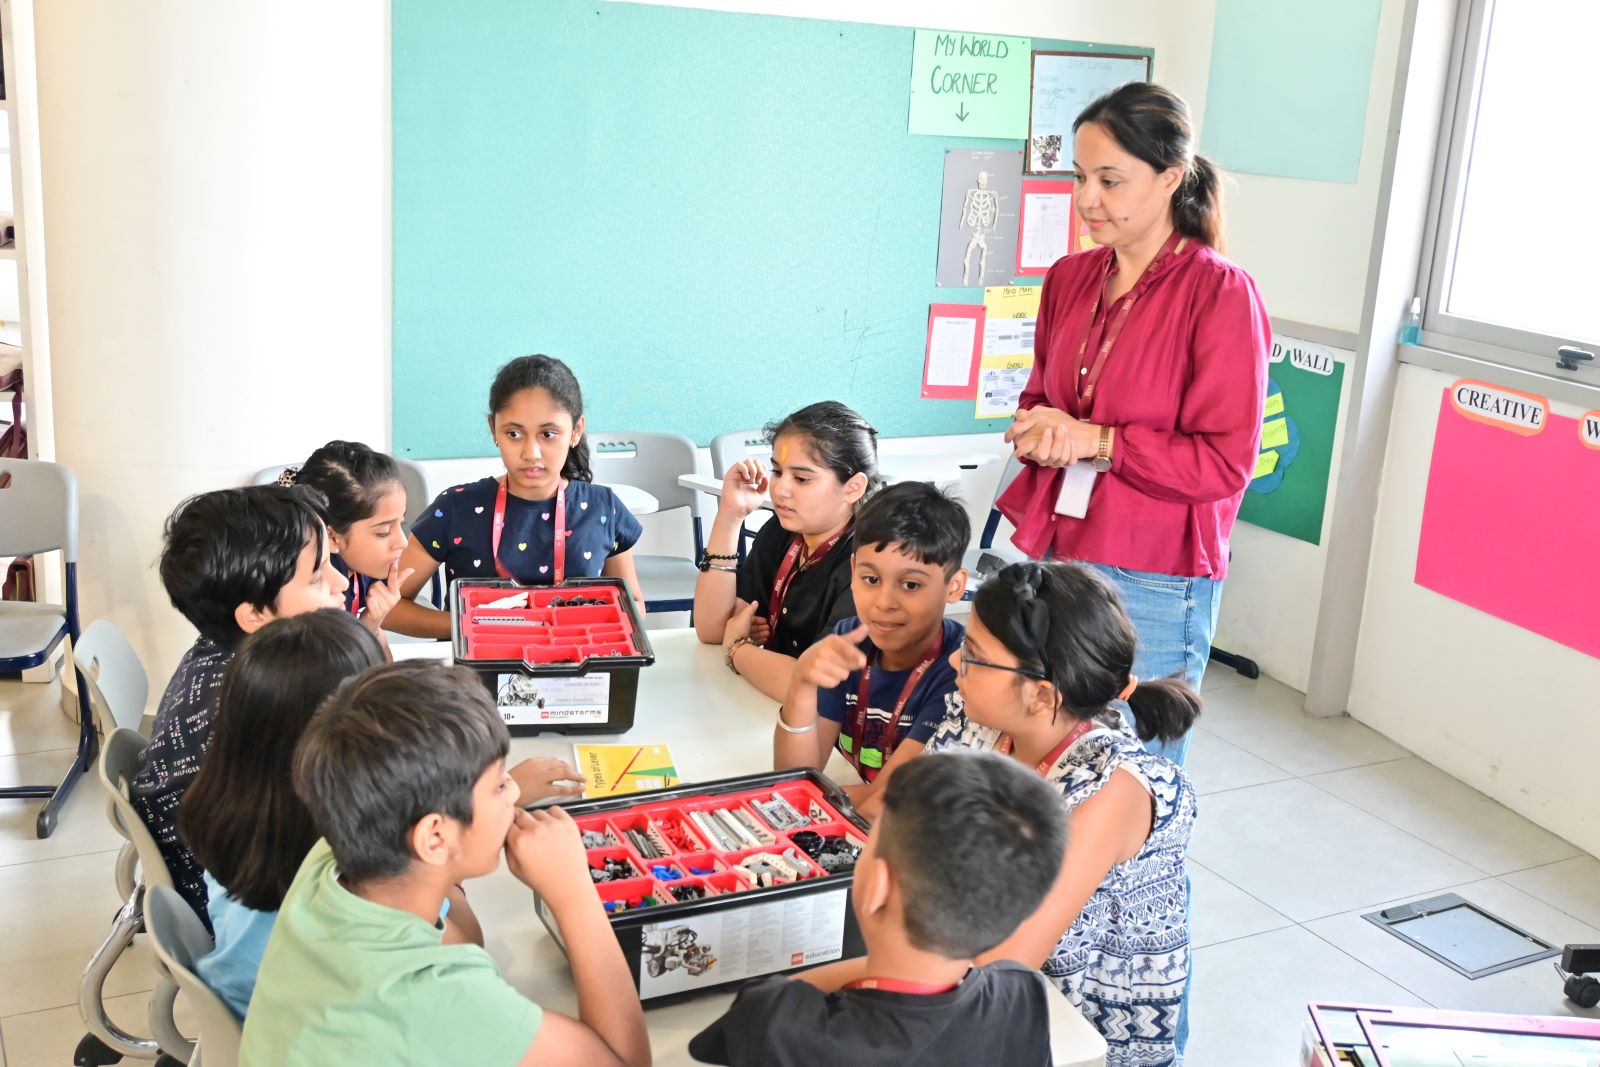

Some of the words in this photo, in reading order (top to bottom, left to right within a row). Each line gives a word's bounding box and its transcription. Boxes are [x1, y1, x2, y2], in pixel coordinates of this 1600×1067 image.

[960, 35, 1009, 59] WORLD
[930, 65, 998, 95] CORNER
[1293, 347, 1331, 373] WALL
[1457, 387, 1543, 425] CREATIVE
[173, 755, 196, 767] TOMMY
[173, 765, 201, 777] HILFIGER
[805, 947, 841, 960] education
